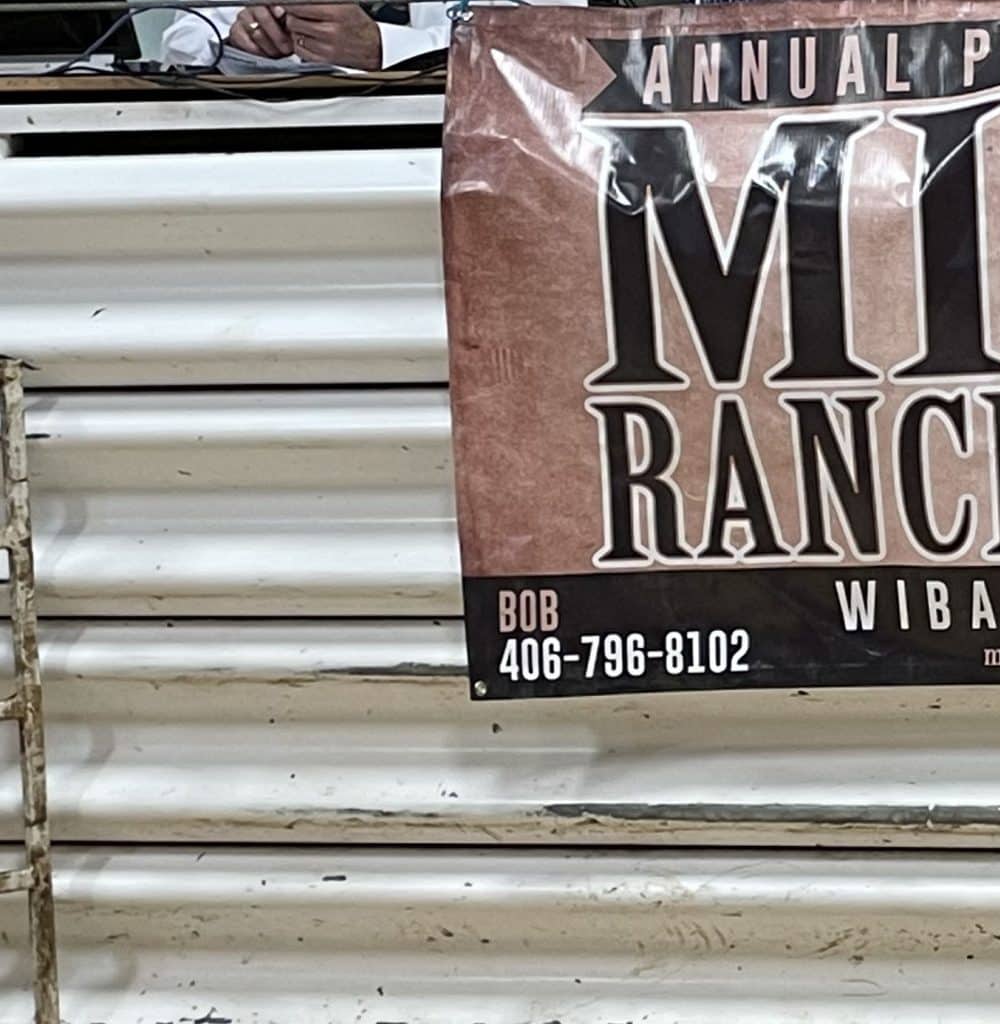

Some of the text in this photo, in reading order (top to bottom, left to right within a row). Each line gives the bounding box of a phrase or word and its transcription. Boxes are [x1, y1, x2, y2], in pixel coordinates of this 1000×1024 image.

[641, 31, 912, 106] ANNUAL
[499, 589, 560, 634] BOB
[498, 628, 751, 682] 406-796-8102
